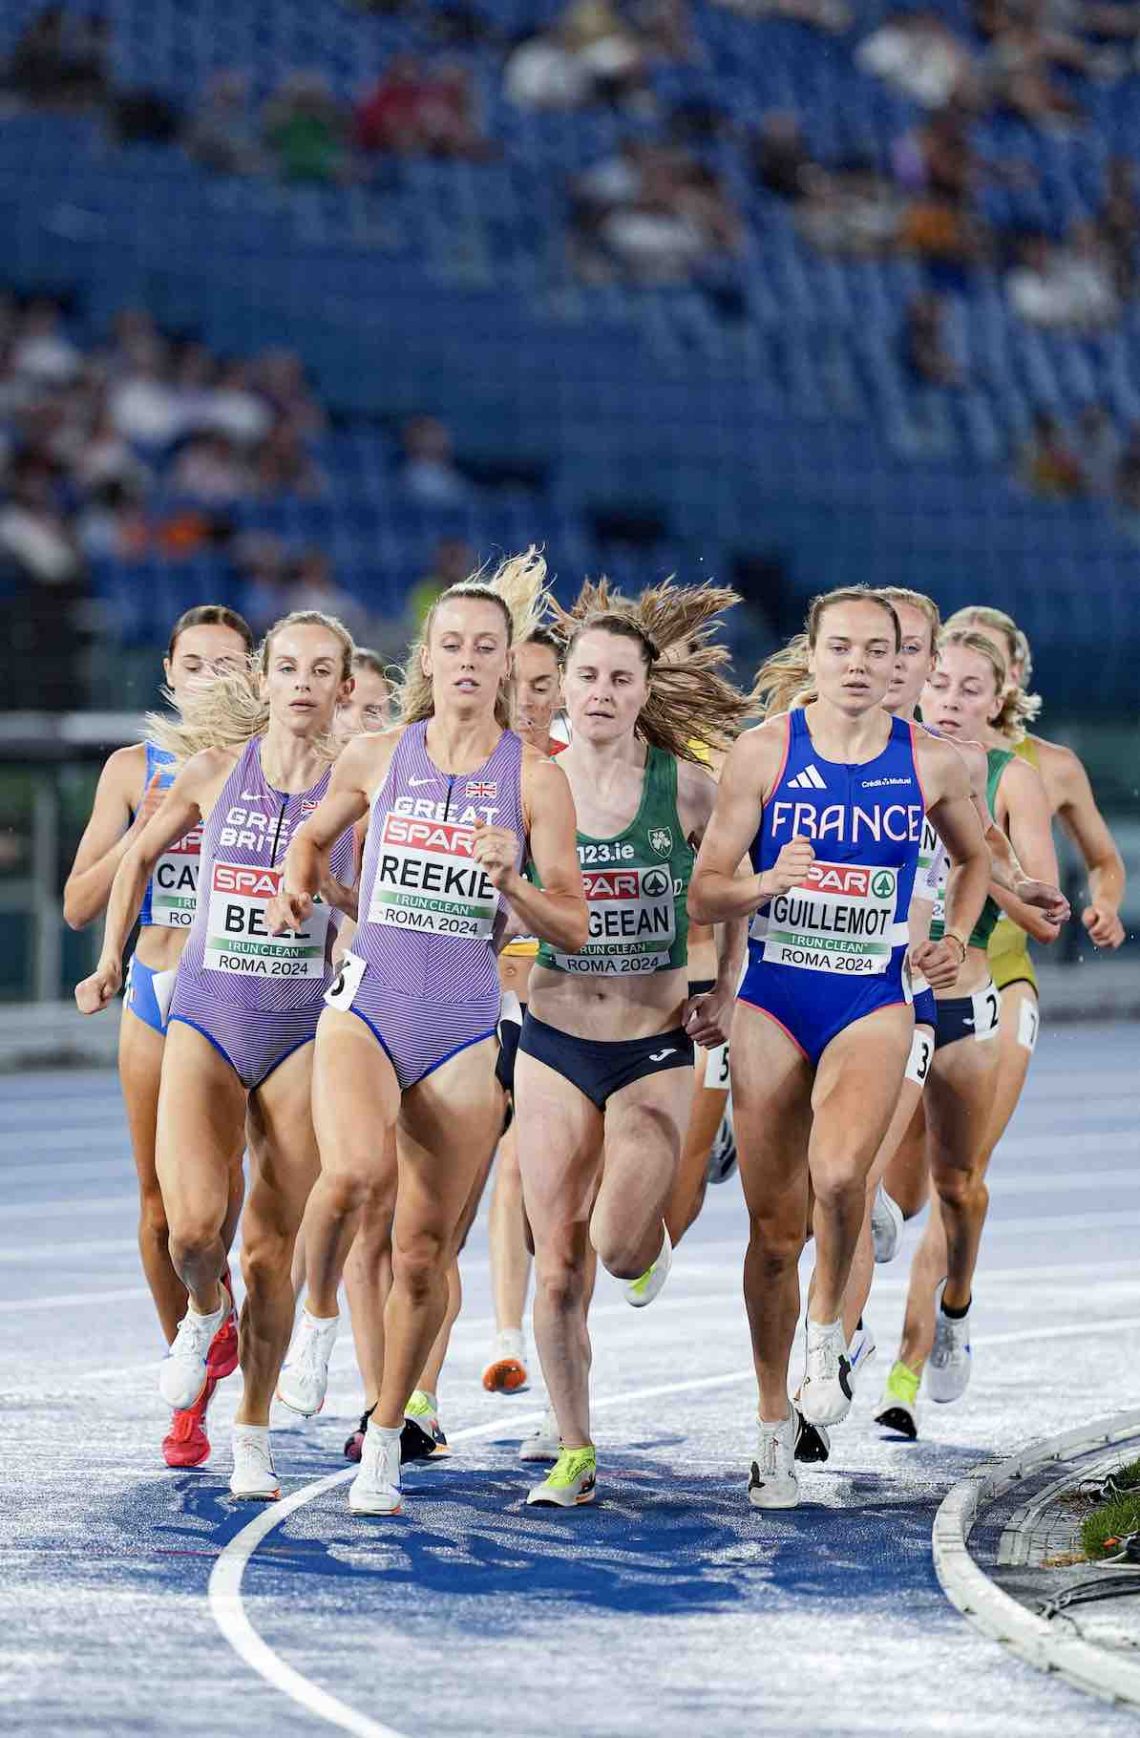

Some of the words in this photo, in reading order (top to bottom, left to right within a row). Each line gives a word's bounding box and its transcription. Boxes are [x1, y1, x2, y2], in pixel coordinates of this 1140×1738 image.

[772, 802, 921, 843] FRANCE
[386, 820, 475, 856] SPAR
[576, 843, 634, 864] 123.ie
[157, 863, 199, 891] CA
[379, 855, 494, 899] REEKIE
[807, 867, 866, 893] PAR
[169, 912, 195, 925] RO
[402, 897, 427, 909] RUN
[429, 901, 468, 915] CLEAN
[773, 895, 891, 935] GUILLEMOT
[225, 905, 310, 939] BE
[385, 908, 434, 929] ROMA
[438, 918, 478, 935] 2024
[588, 906, 669, 937] GEEAN
[234, 941, 260, 954] RUN
[261, 944, 299, 957] CLEAN
[607, 943, 646, 955] CLEAN
[798, 936, 823, 949] RUN
[825, 939, 863, 953] CLEAN
[219, 956, 267, 973] ROMA
[271, 960, 308, 975] 2024
[567, 959, 617, 973] ROMA
[621, 957, 659, 971] 2024
[781, 948, 831, 969] ROMA
[836, 956, 873, 971] 2024
[986, 994, 998, 1028] 2
[917, 1043, 929, 1079] 3
